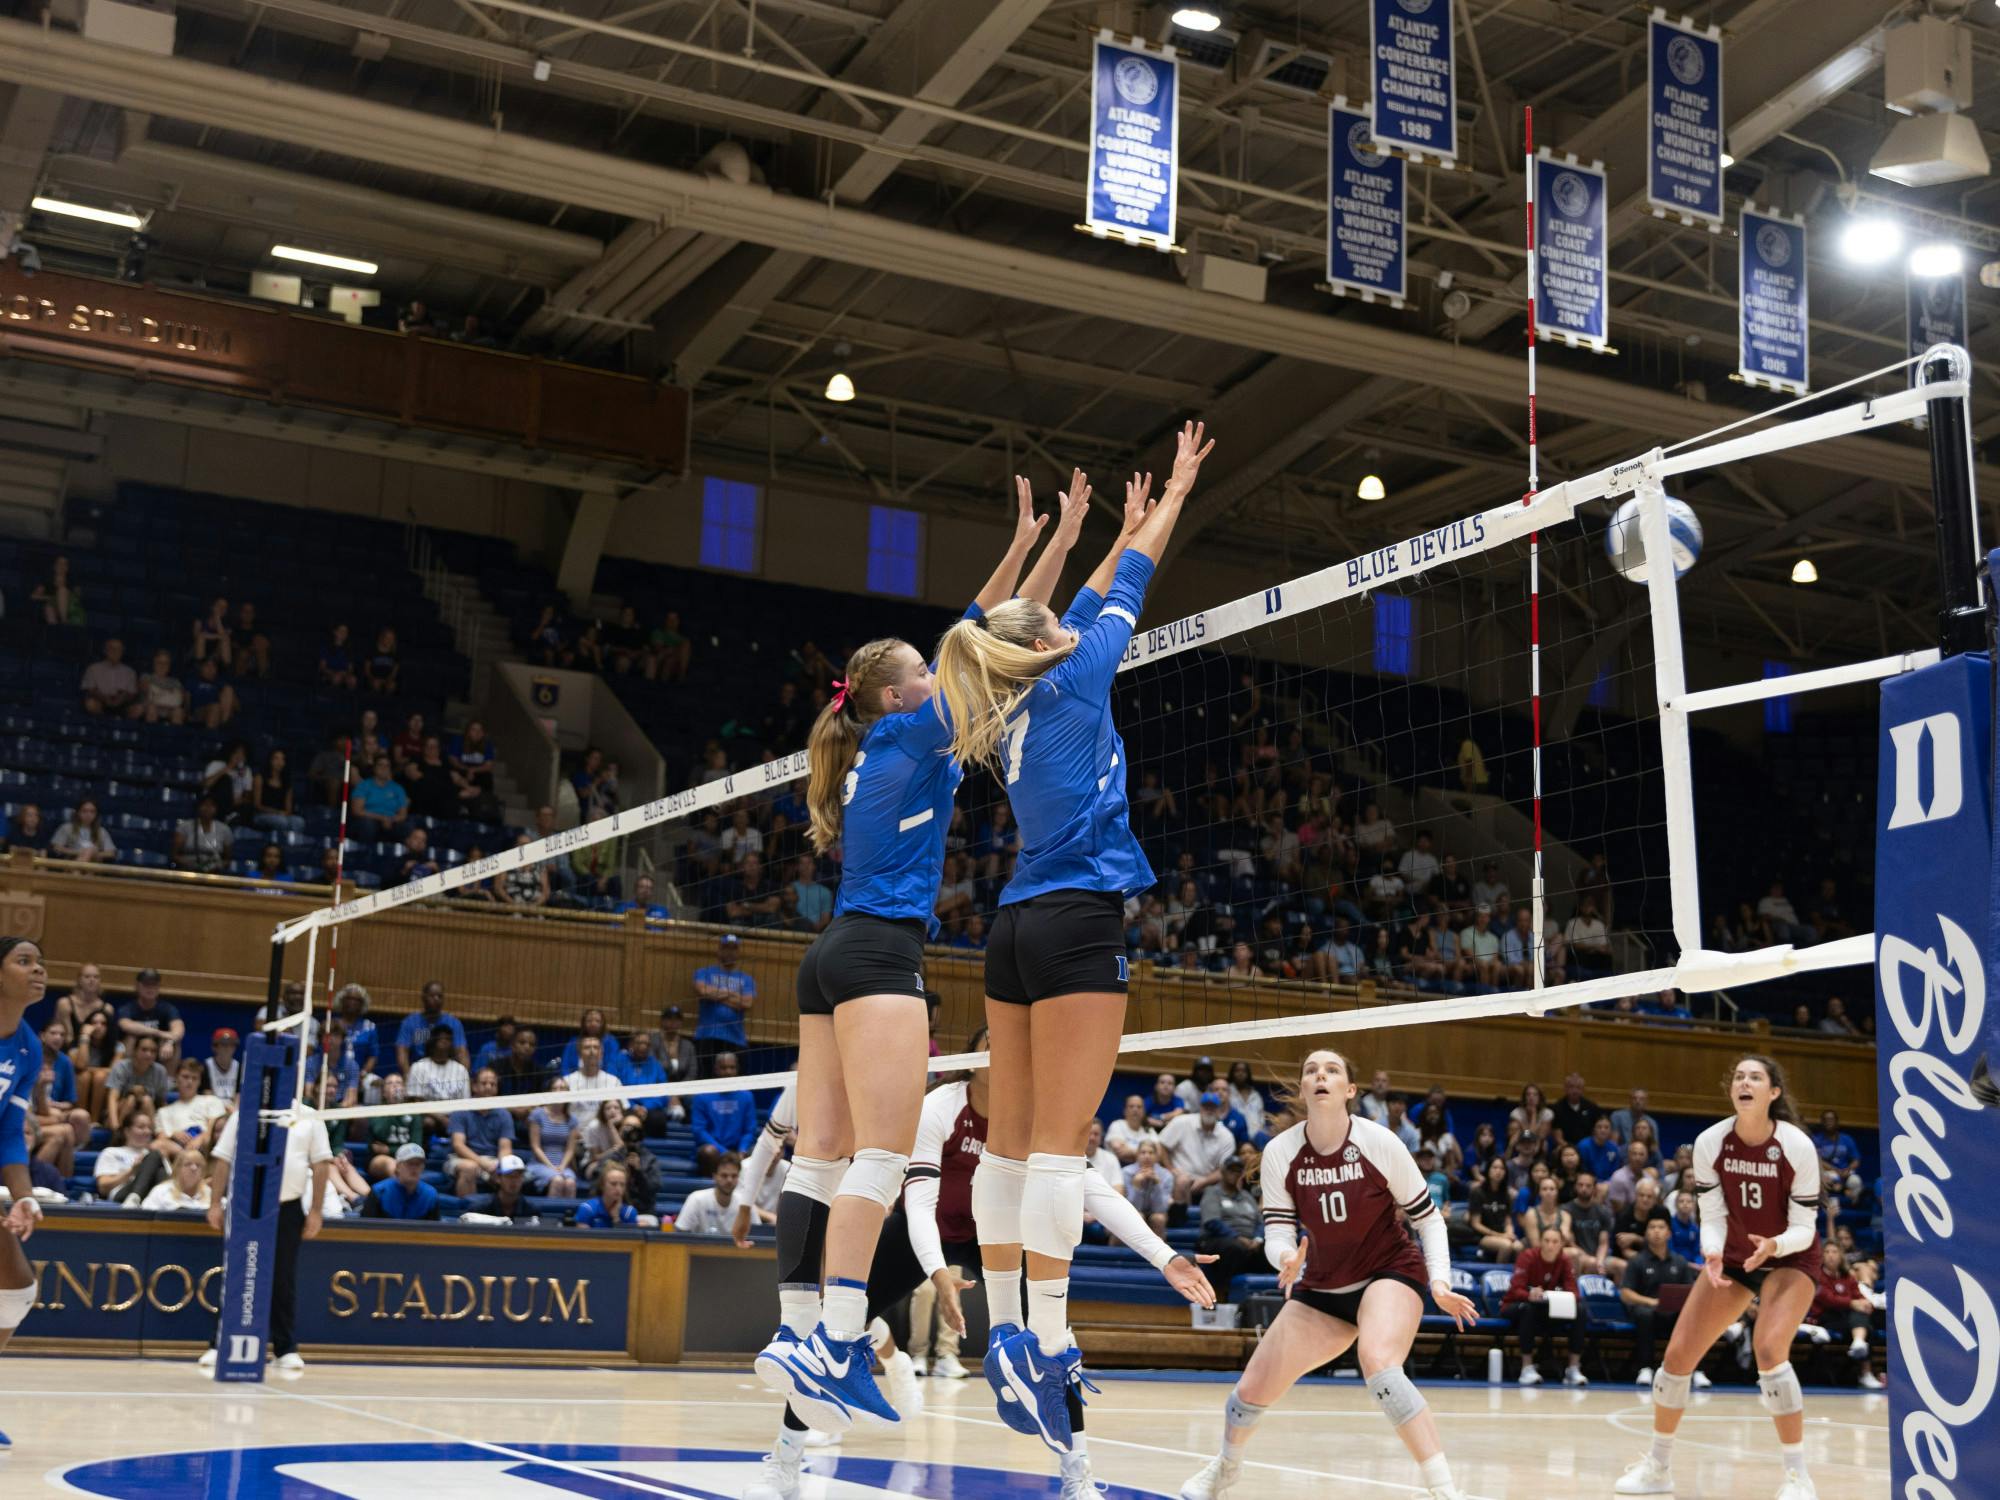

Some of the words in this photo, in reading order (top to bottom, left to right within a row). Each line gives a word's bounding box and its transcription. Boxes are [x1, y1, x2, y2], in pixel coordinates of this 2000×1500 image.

[1388, 14, 1440, 40] ATLANTIC
[1395, 33, 1431, 54] COAST
[1378, 45, 1449, 75] CONFERENCE
[1388, 63, 1441, 88] WOMEN'S
[1381, 78, 1447, 107] CHAMPIONS
[1664, 85, 1709, 111] ATLANTIC
[1108, 106, 1161, 131] ATLANTIC
[1670, 102, 1702, 123] COAST
[1400, 120, 1432, 140] 1998
[1654, 112, 1717, 144] CONFERENCE
[1663, 130, 1710, 157] WOMEN'S
[1656, 144, 1715, 174] CHAMPIONS
[1344, 168, 1392, 192] ATLANTIC
[1351, 185, 1385, 205] COAST
[1672, 184, 1700, 204] 1999
[1334, 195, 1401, 224] CONFERENCE
[1343, 212, 1393, 236] WOMEN'S
[1548, 218, 1593, 240] ATLANTIC
[1337, 225, 1398, 253] CHAMPIONS
[1555, 235, 1587, 253] COAST
[1540, 244, 1601, 271] CONFERENCE
[1353, 263, 1383, 282] 2003
[1548, 260, 1594, 283] WOMEN'S
[1754, 268, 1795, 289] ATLANTIC
[1542, 272, 1599, 299] CHAMPIONS
[1760, 283, 1789, 301] COAST
[69, 304, 231, 354] STADIUM
[1557, 309, 1585, 328] 2004
[1753, 309, 1796, 330] WOMEN'S
[1747, 321, 1801, 345] CHAMPIONS
[1618, 461, 1643, 475] Senoh
[1147, 613, 1206, 654] DEVILS
[1346, 545, 1399, 588] BLUE
[1411, 513, 1485, 566] DEVILS
[1887, 711, 1962, 830] D
[544, 835, 563, 853] BLUE
[564, 825, 590, 848] DEVILS
[643, 804, 665, 821] BLUE
[667, 787, 697, 812] DEVILS
[764, 756, 790, 783] BLUE
[1880, 912, 1986, 1242] Blue
[1297, 1162, 1365, 1186] CAROLINA
[1723, 1157, 1778, 1178] CAROLINA
[1318, 1190, 1347, 1224] 10
[1739, 1181, 1762, 1209] 13
[245, 1240, 259, 1279] sports
[32, 1260, 225, 1314] INDOO
[328, 1269, 593, 1325] STADIUM
[240, 1278, 255, 1327] imports
[227, 1334, 260, 1363] D
